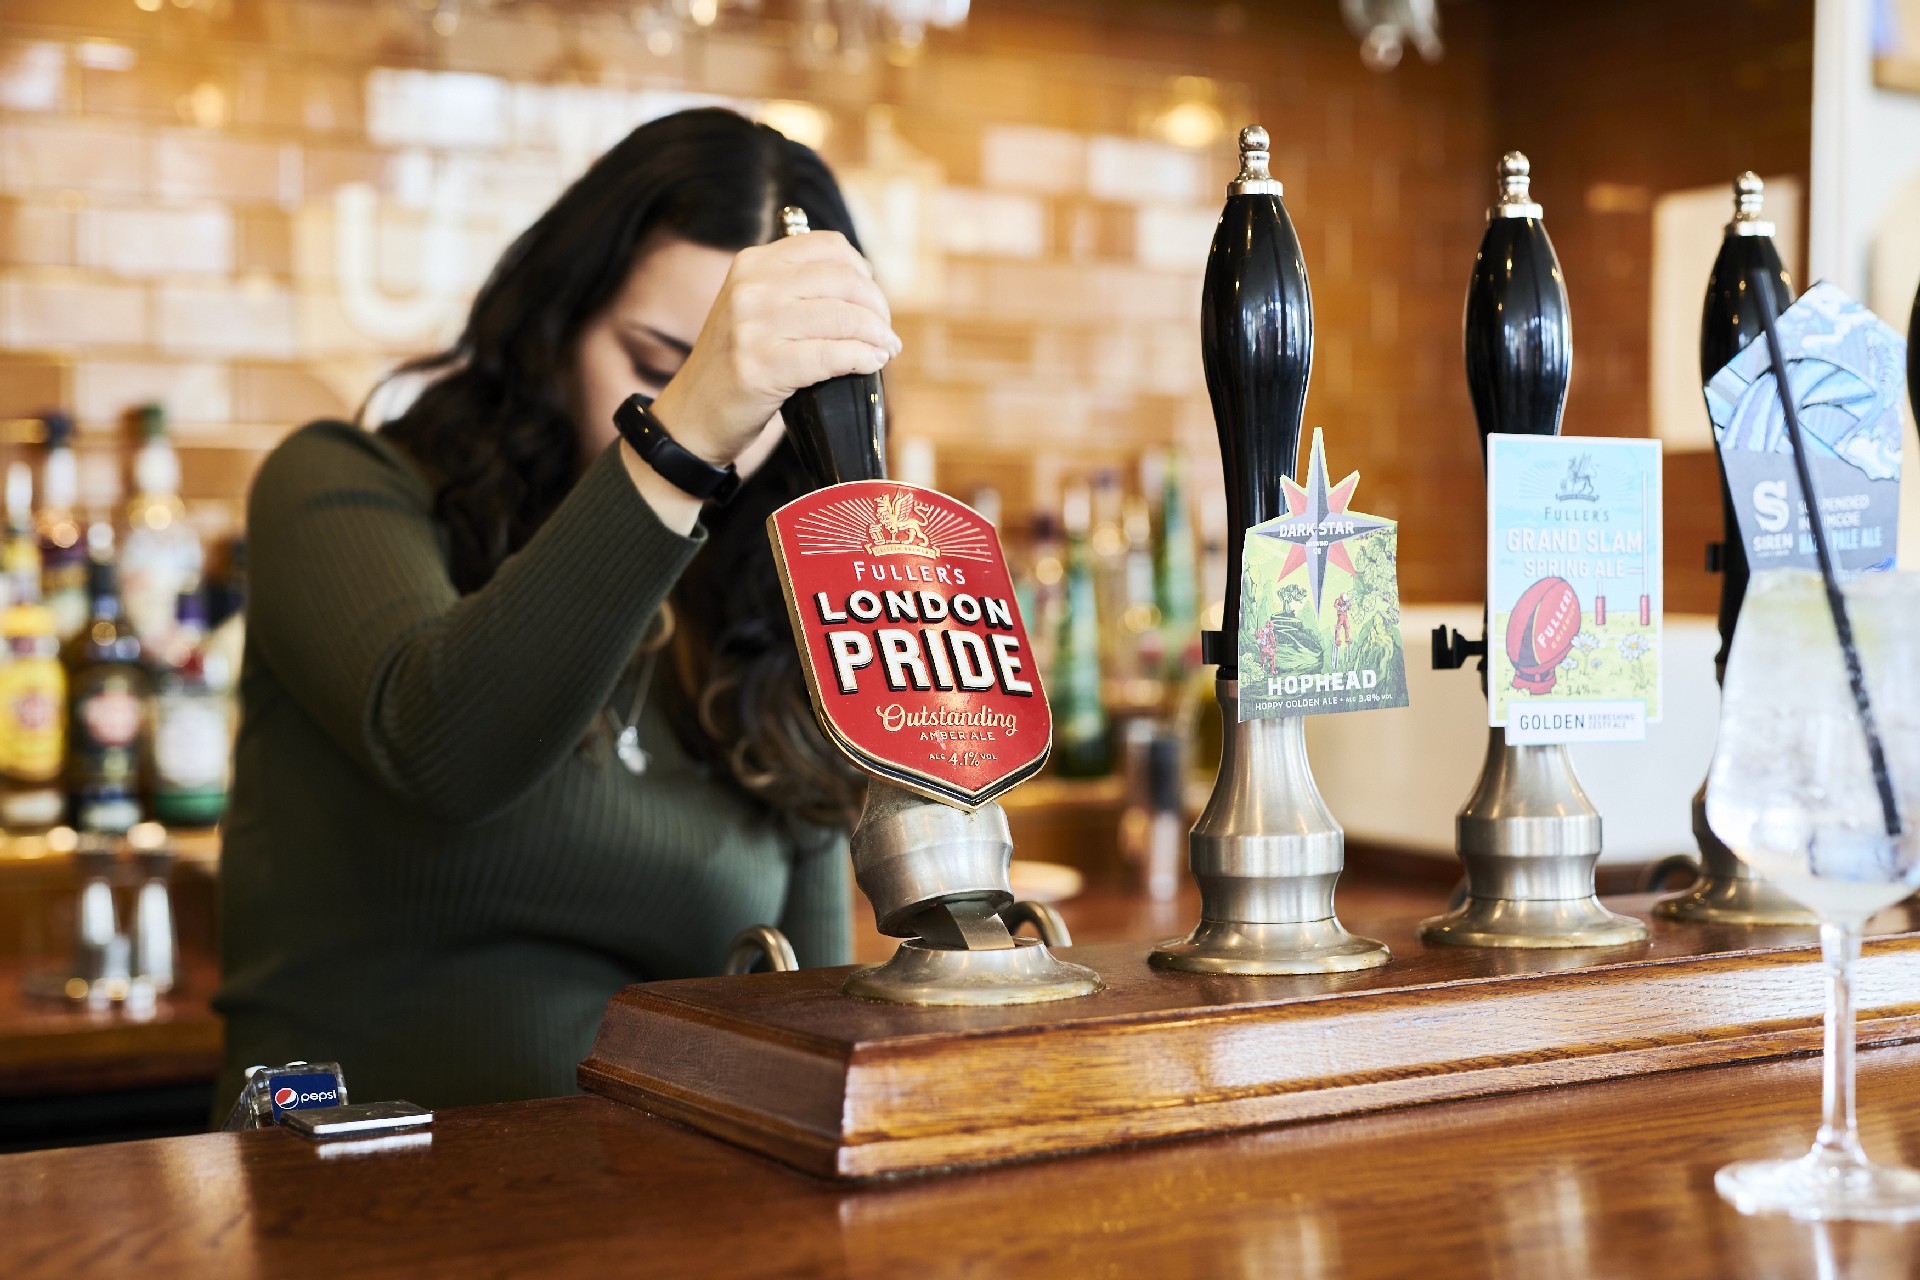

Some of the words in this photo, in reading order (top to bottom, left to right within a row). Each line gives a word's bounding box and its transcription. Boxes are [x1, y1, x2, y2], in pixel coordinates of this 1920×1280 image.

[1545, 506, 1609, 522] FULLER'S
[1279, 522, 1316, 538] DARK
[1318, 520, 1355, 536] STAR
[1506, 527, 1581, 553] GRAND
[1586, 528, 1642, 554] SLAM
[1753, 533, 1793, 551] SIREN
[853, 560, 966, 586] FULLER'S
[1524, 558, 1590, 578] SPRING
[1595, 559, 1625, 579] ALE
[814, 590, 1014, 630] LONDON
[826, 629, 1034, 697] PRIDE
[1267, 669, 1377, 696] HOPHEAD
[1255, 702, 1283, 711] HOPPY
[1286, 699, 1320, 709] GOLDEN
[1322, 697, 1338, 706] ALE
[1358, 694, 1381, 703] 3.8%
[875, 703, 1018, 736] Outstanding
[1520, 714, 1585, 730] GOLDEN
[919, 731, 966, 741] AMBER
[971, 731, 996, 741] ALE
[948, 751, 980, 766] 4.1%
[301, 1090, 336, 1103] pepsi
